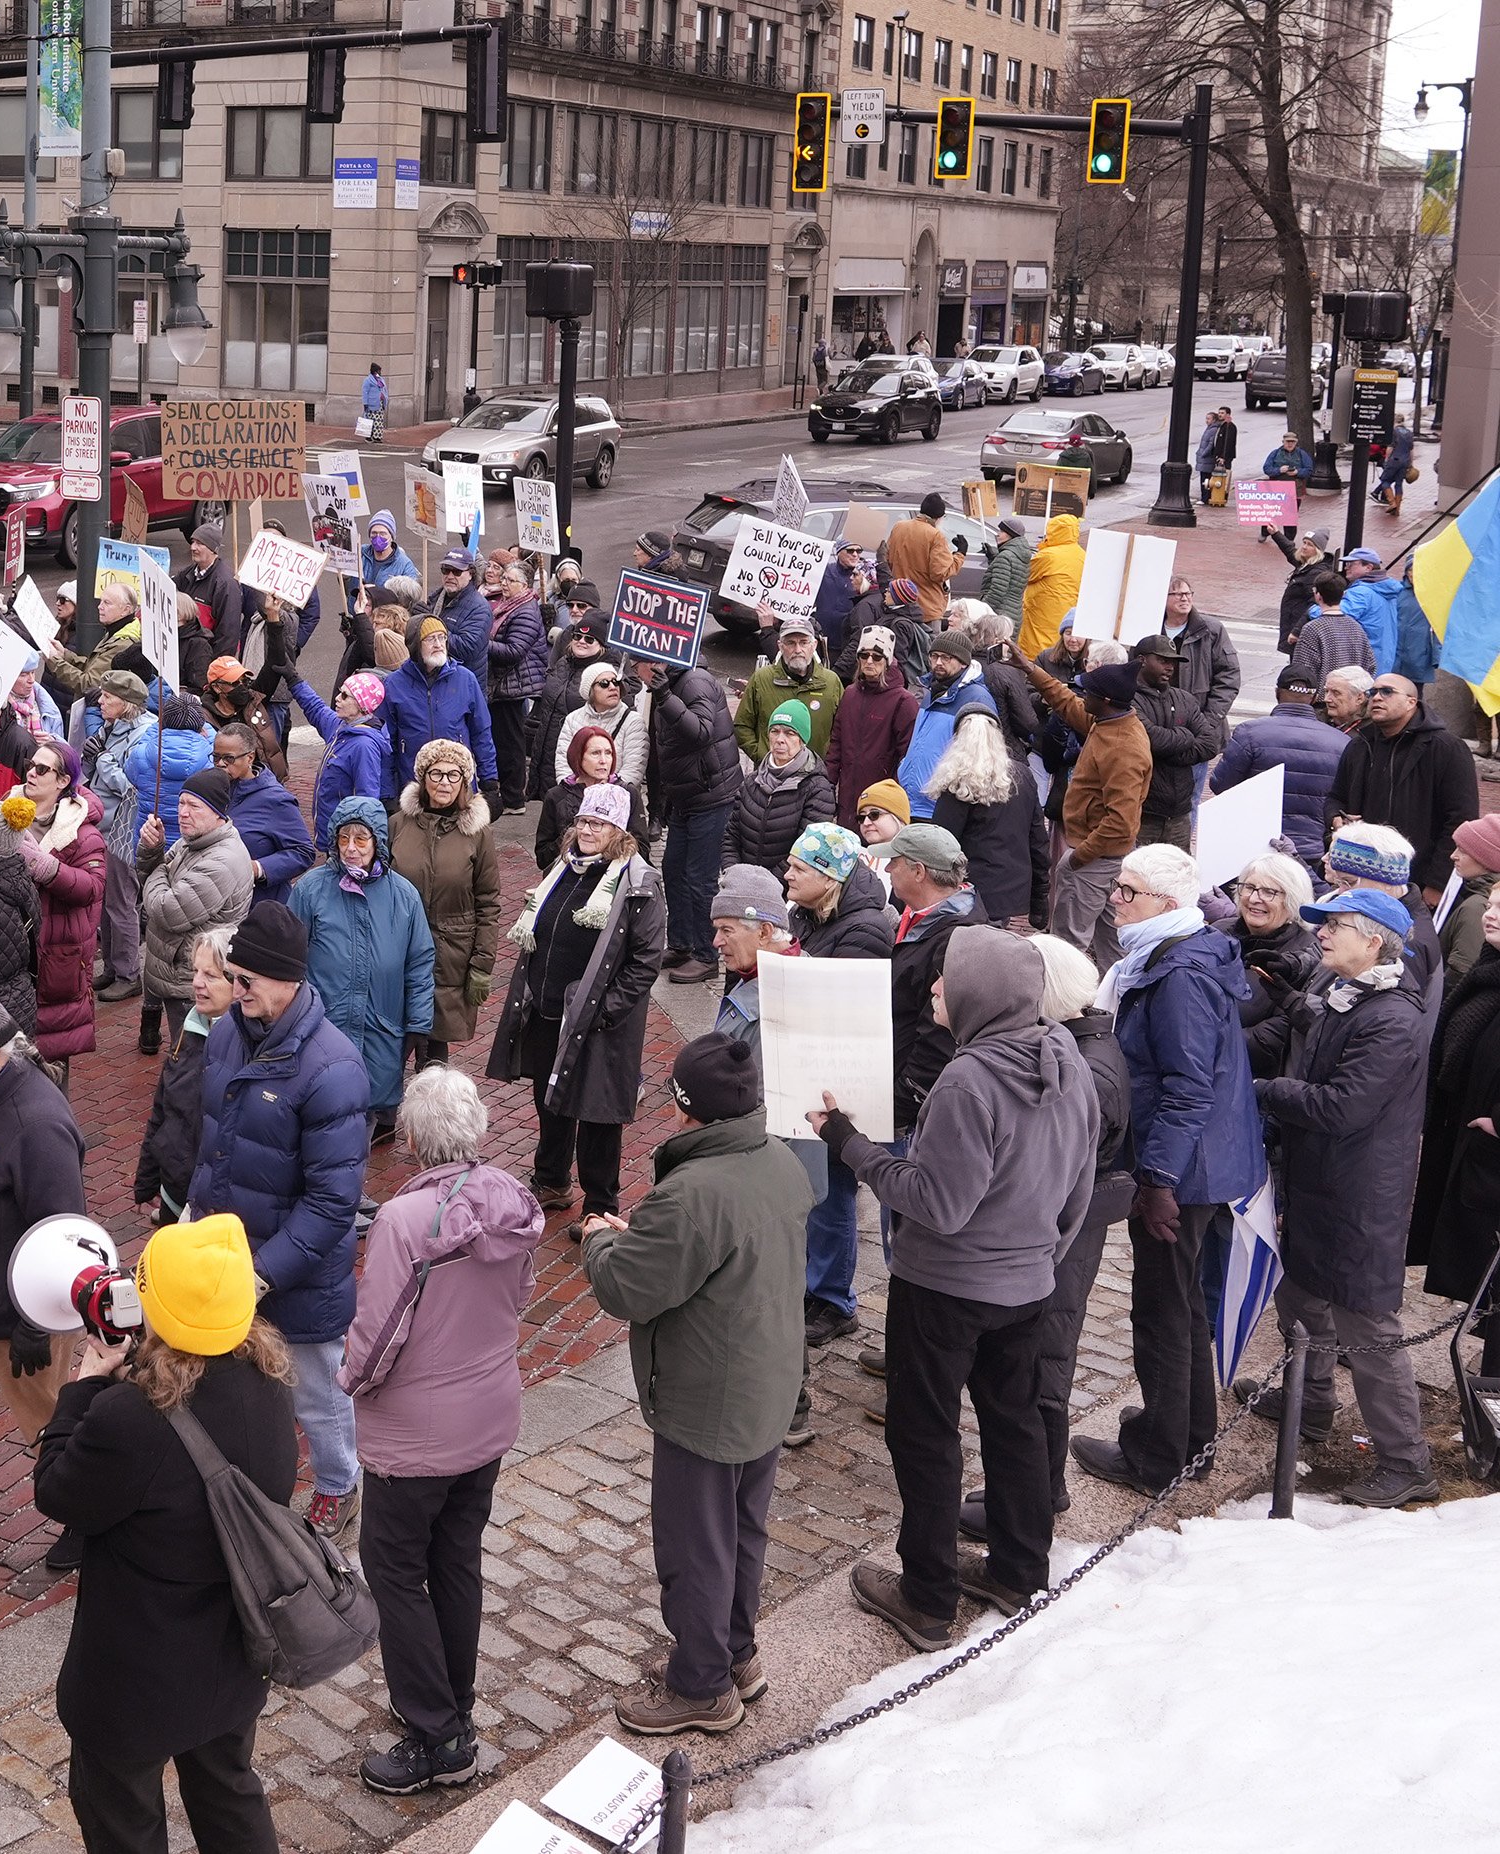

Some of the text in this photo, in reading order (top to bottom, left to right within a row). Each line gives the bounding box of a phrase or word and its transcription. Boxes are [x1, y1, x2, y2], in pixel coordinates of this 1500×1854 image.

[63, 44, 71, 93] Institute
[52, 69, 60, 126] University
[852, 103, 874, 111] YIELD
[74, 403, 88, 417] NO
[166, 401, 297, 421] SEN. COLLINS:
[65, 420, 97, 434] PARKING
[181, 421, 297, 446] DECLARATION
[67, 436, 95, 447] THIS SIDE
[65, 448, 97, 459] OF STREET
[164, 454, 175, 468] of
[445, 464, 480, 476] WORK FOR
[316, 484, 337, 497] FORK
[457, 481, 472, 497] ME
[521, 482, 551, 497] I STAND
[335, 499, 347, 510] OFF
[517, 500, 550, 518] UKRAINE
[458, 512, 474, 528] US
[521, 533, 527, 541] A
[529, 535, 539, 544] BAD
[525, 524, 551, 537] PUTIN IS
[104, 544, 132, 566] Trump
[752, 527, 824, 563] Tell Your City
[252, 538, 323, 578] AMERICAN
[744, 545, 812, 577] Council Rep
[257, 565, 311, 602] VALUES
[737, 569, 810, 596] NO TESLA
[143, 571, 173, 635] WAKE
[622, 586, 698, 626] STOP THE
[730, 583, 800, 615] at 35 Riverside
[152, 620, 168, 668] UP
[619, 618, 688, 657] TYRANT
[591, 1769, 649, 1825] MUSK MUST GO!
[608, 1818, 632, 1838] GO!
[538, 1834, 561, 1854] MUS
